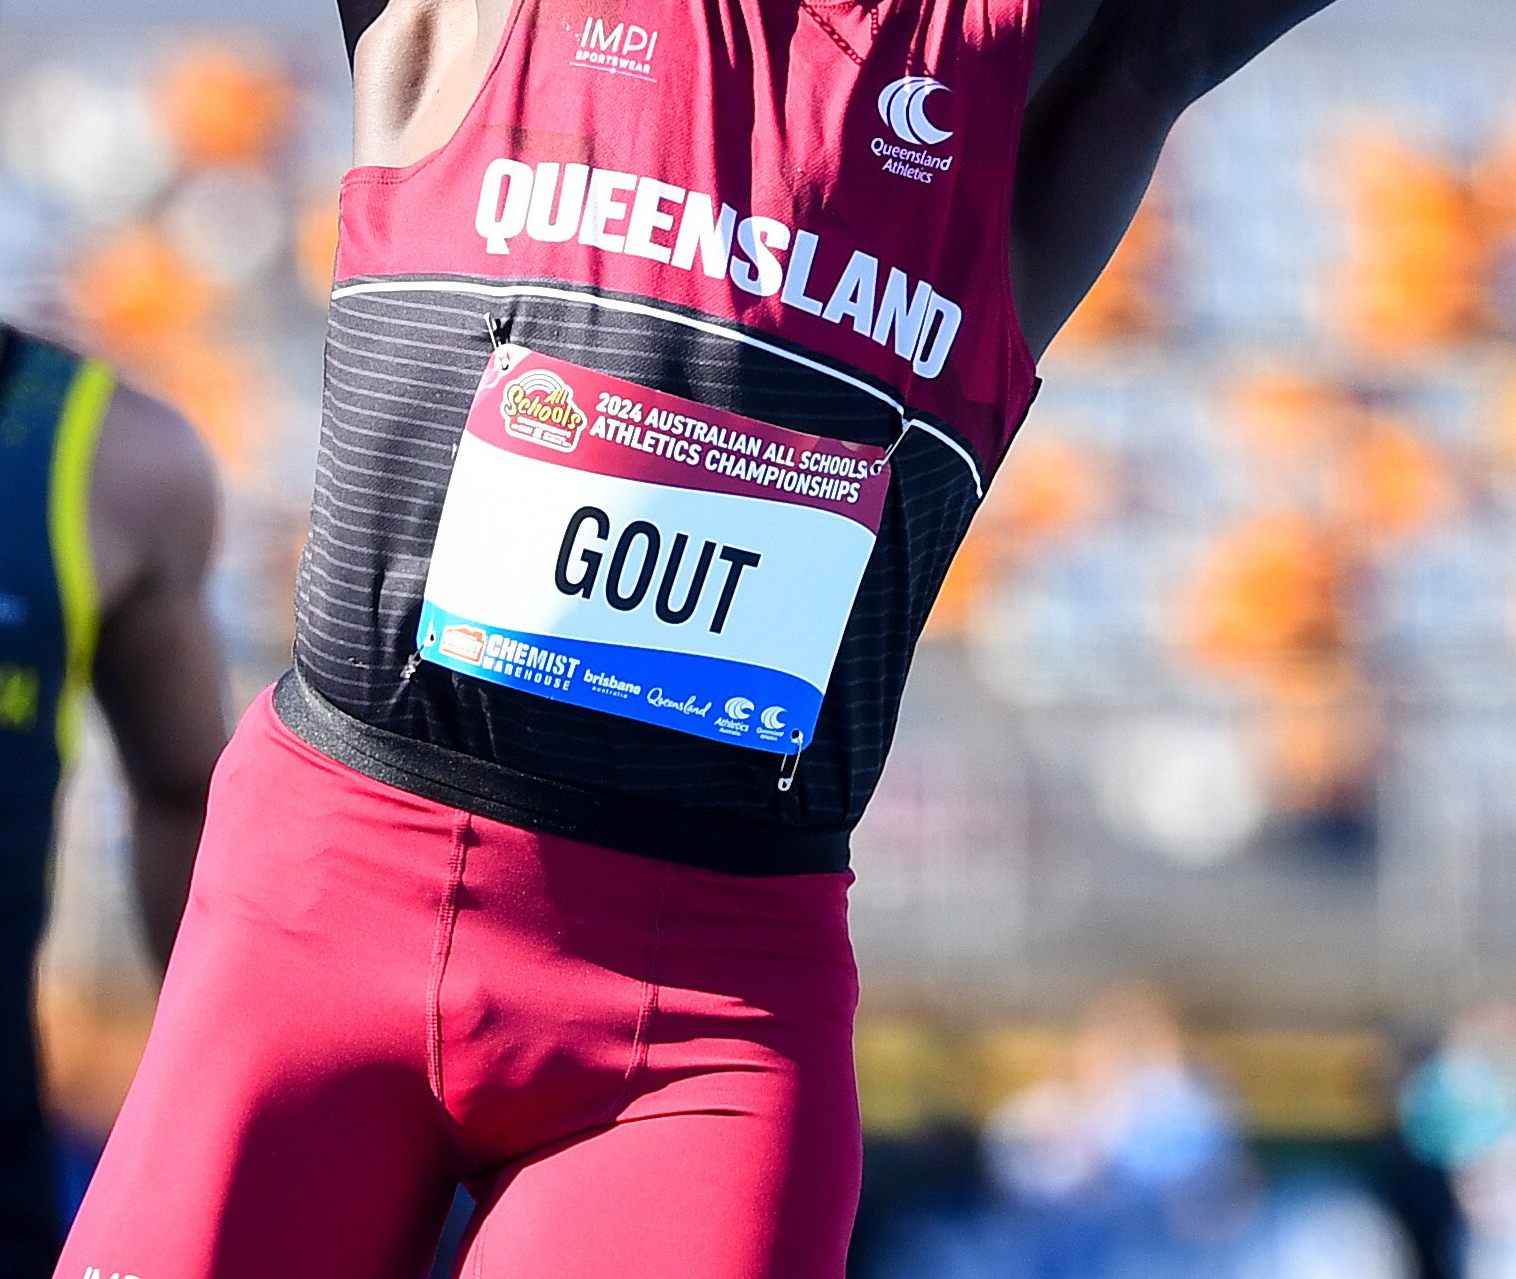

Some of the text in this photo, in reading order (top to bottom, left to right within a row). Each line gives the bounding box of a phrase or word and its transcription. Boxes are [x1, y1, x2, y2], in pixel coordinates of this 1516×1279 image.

[580, 16, 658, 61] IMPI
[575, 50, 651, 74] SPORTSWEAR
[870, 137, 953, 171] Queensland
[881, 157, 933, 184] Athletics
[475, 158, 962, 379] QUEENSLAND
[504, 384, 583, 430] Schools
[544, 387, 570, 406] All
[595, 391, 868, 480] 2024 AUSTRALIAN ALL SCHOOLS
[589, 415, 701, 466] ATHLETICS
[704, 449, 861, 504] CHAMPIONSHIPS
[554, 505, 762, 635] GOUT
[481, 655, 571, 692] WAREHOUSE
[486, 633, 581, 679] CHEMIST
[583, 668, 713, 718] brisbane Queensland
